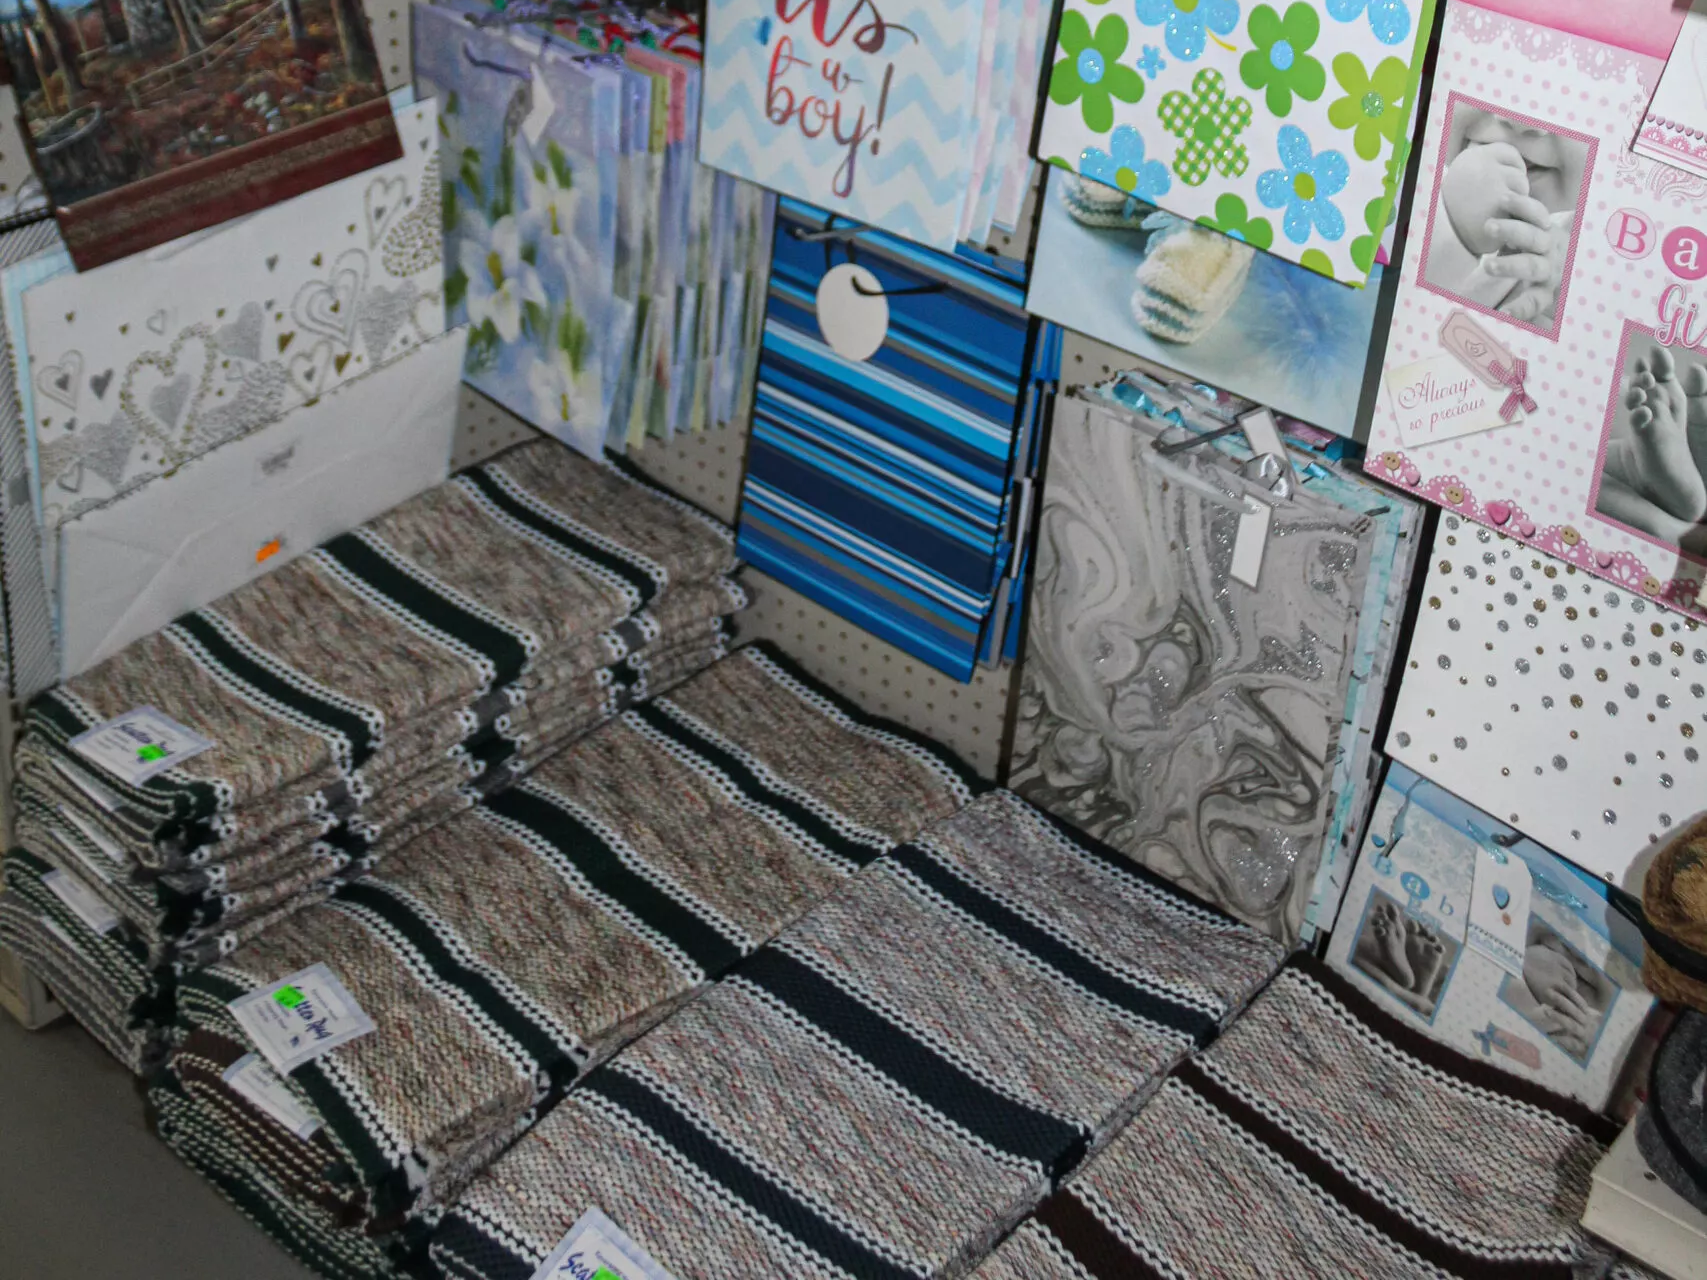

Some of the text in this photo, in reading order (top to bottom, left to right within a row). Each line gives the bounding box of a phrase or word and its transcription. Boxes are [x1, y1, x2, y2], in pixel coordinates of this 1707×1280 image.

[821, 58, 863, 93] a
[766, 35, 895, 199] boy!
[1655, 283, 1707, 348] Gi
[1398, 372, 1476, 410] Always
[1430, 398, 1486, 433] precious
